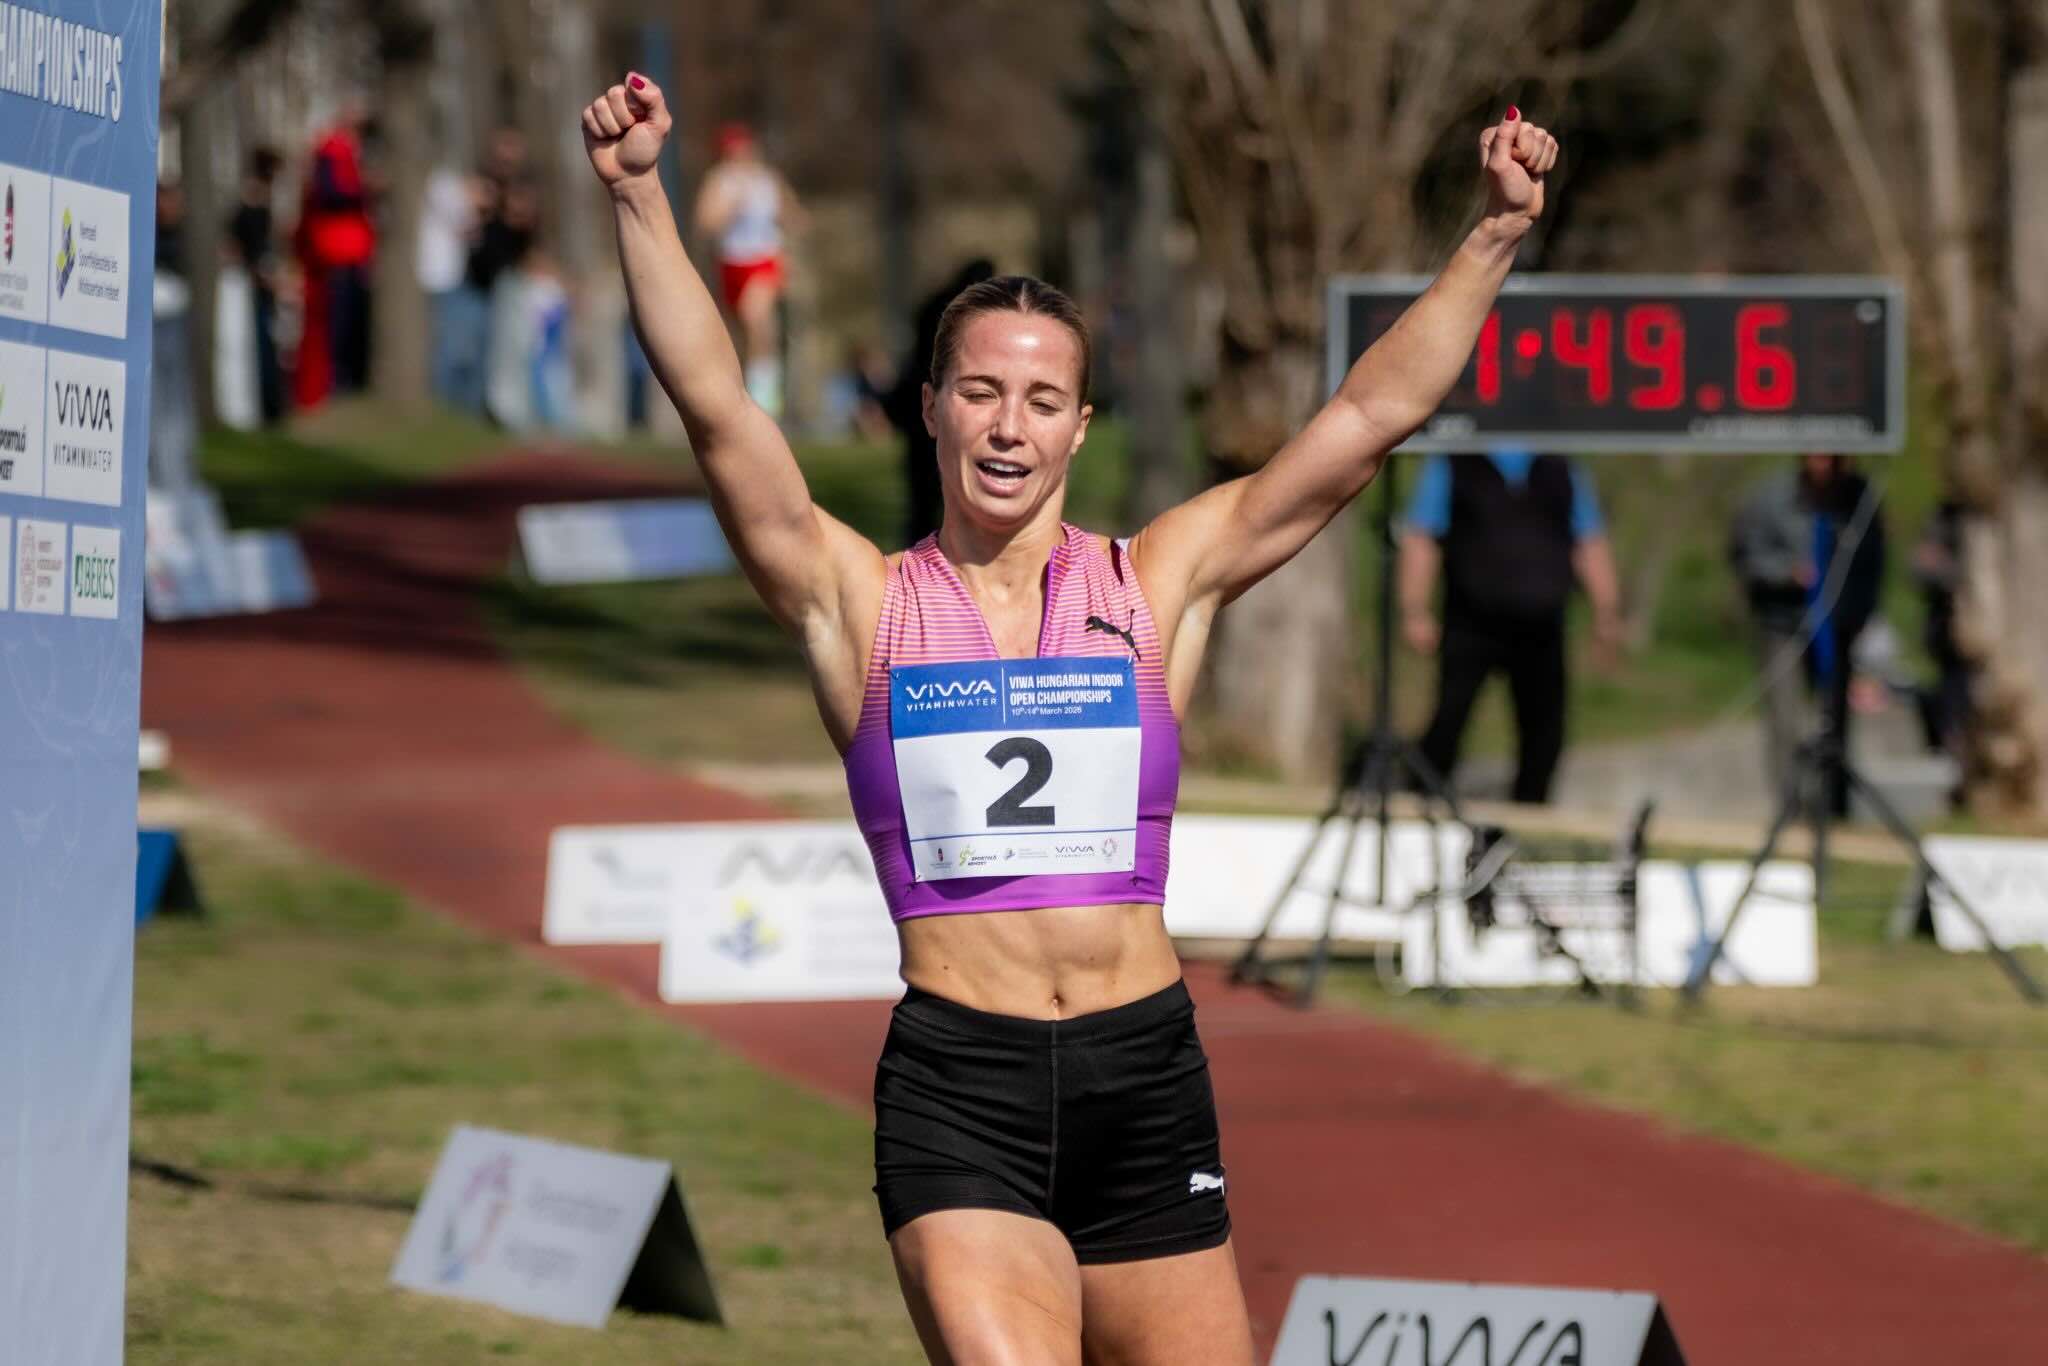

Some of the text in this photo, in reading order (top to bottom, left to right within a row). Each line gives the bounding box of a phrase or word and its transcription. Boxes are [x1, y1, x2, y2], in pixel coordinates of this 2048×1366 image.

[53, 443, 112, 473] VITAMINWATER
[85, 547, 115, 600] BÉRES
[1009, 673, 1123, 689] VIWA HUNGARIAN INDOOR
[906, 699, 997, 712] VITAMINWATER
[1010, 690, 1112, 705] OPEN CHAMPIONSHIPS
[1040, 706, 1063, 715] March
[985, 737, 1055, 827] 2
